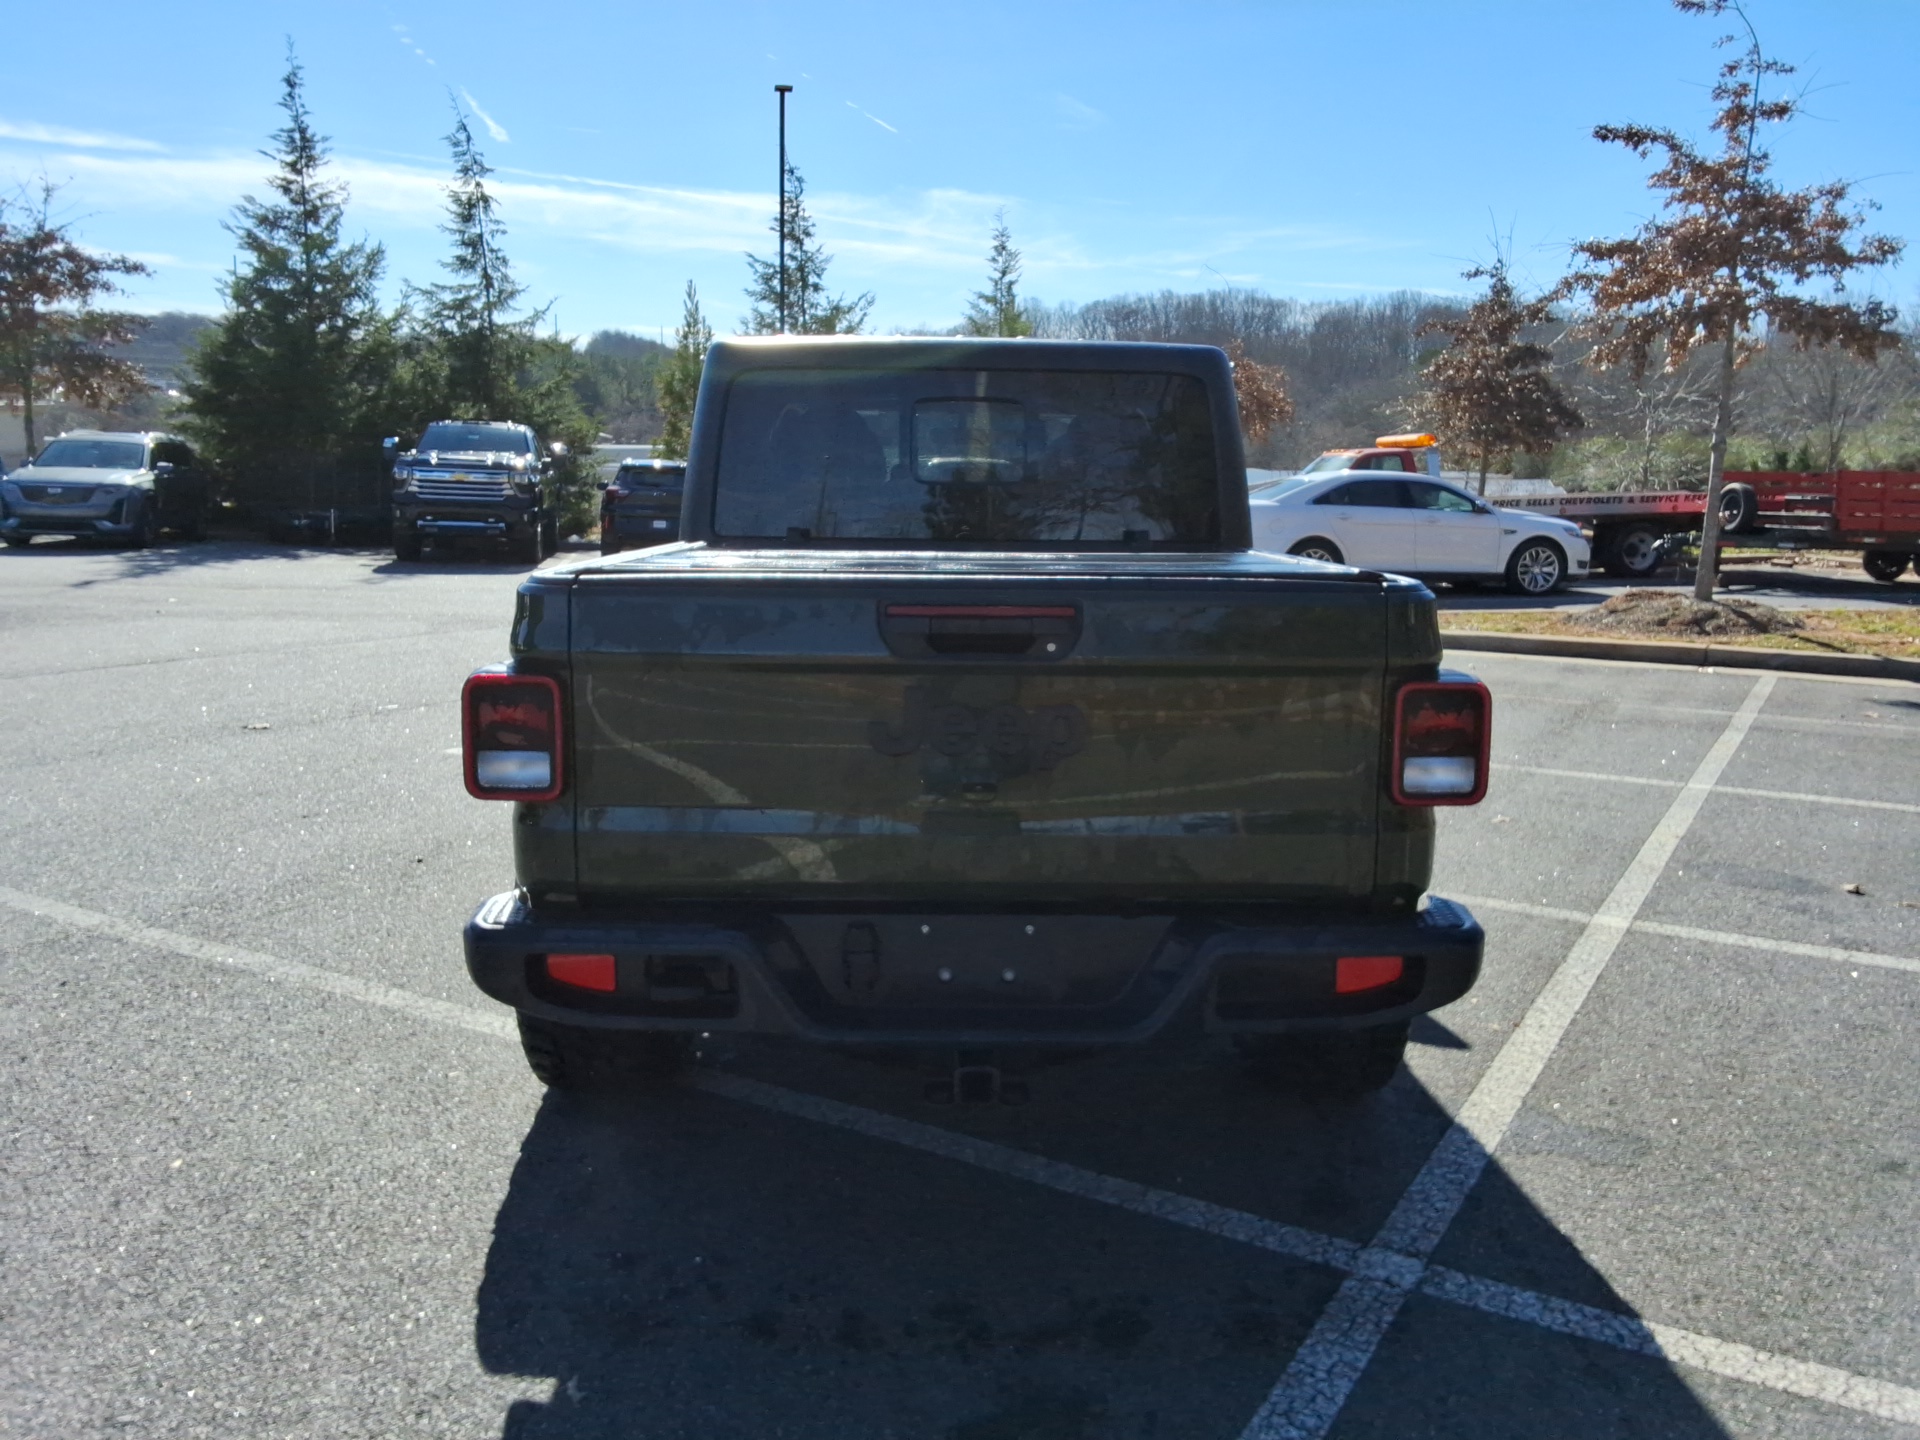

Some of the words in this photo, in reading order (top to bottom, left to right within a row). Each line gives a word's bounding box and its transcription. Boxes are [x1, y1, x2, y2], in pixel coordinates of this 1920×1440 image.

[1491, 498, 1522, 507] PRICE
[1526, 498, 1555, 506] SELLS
[1559, 496, 1624, 505] CHEVROLETS
[1627, 496, 1635, 504] &
[1639, 495, 1680, 504] SERVICE
[867, 685, 1087, 770] Jeep
